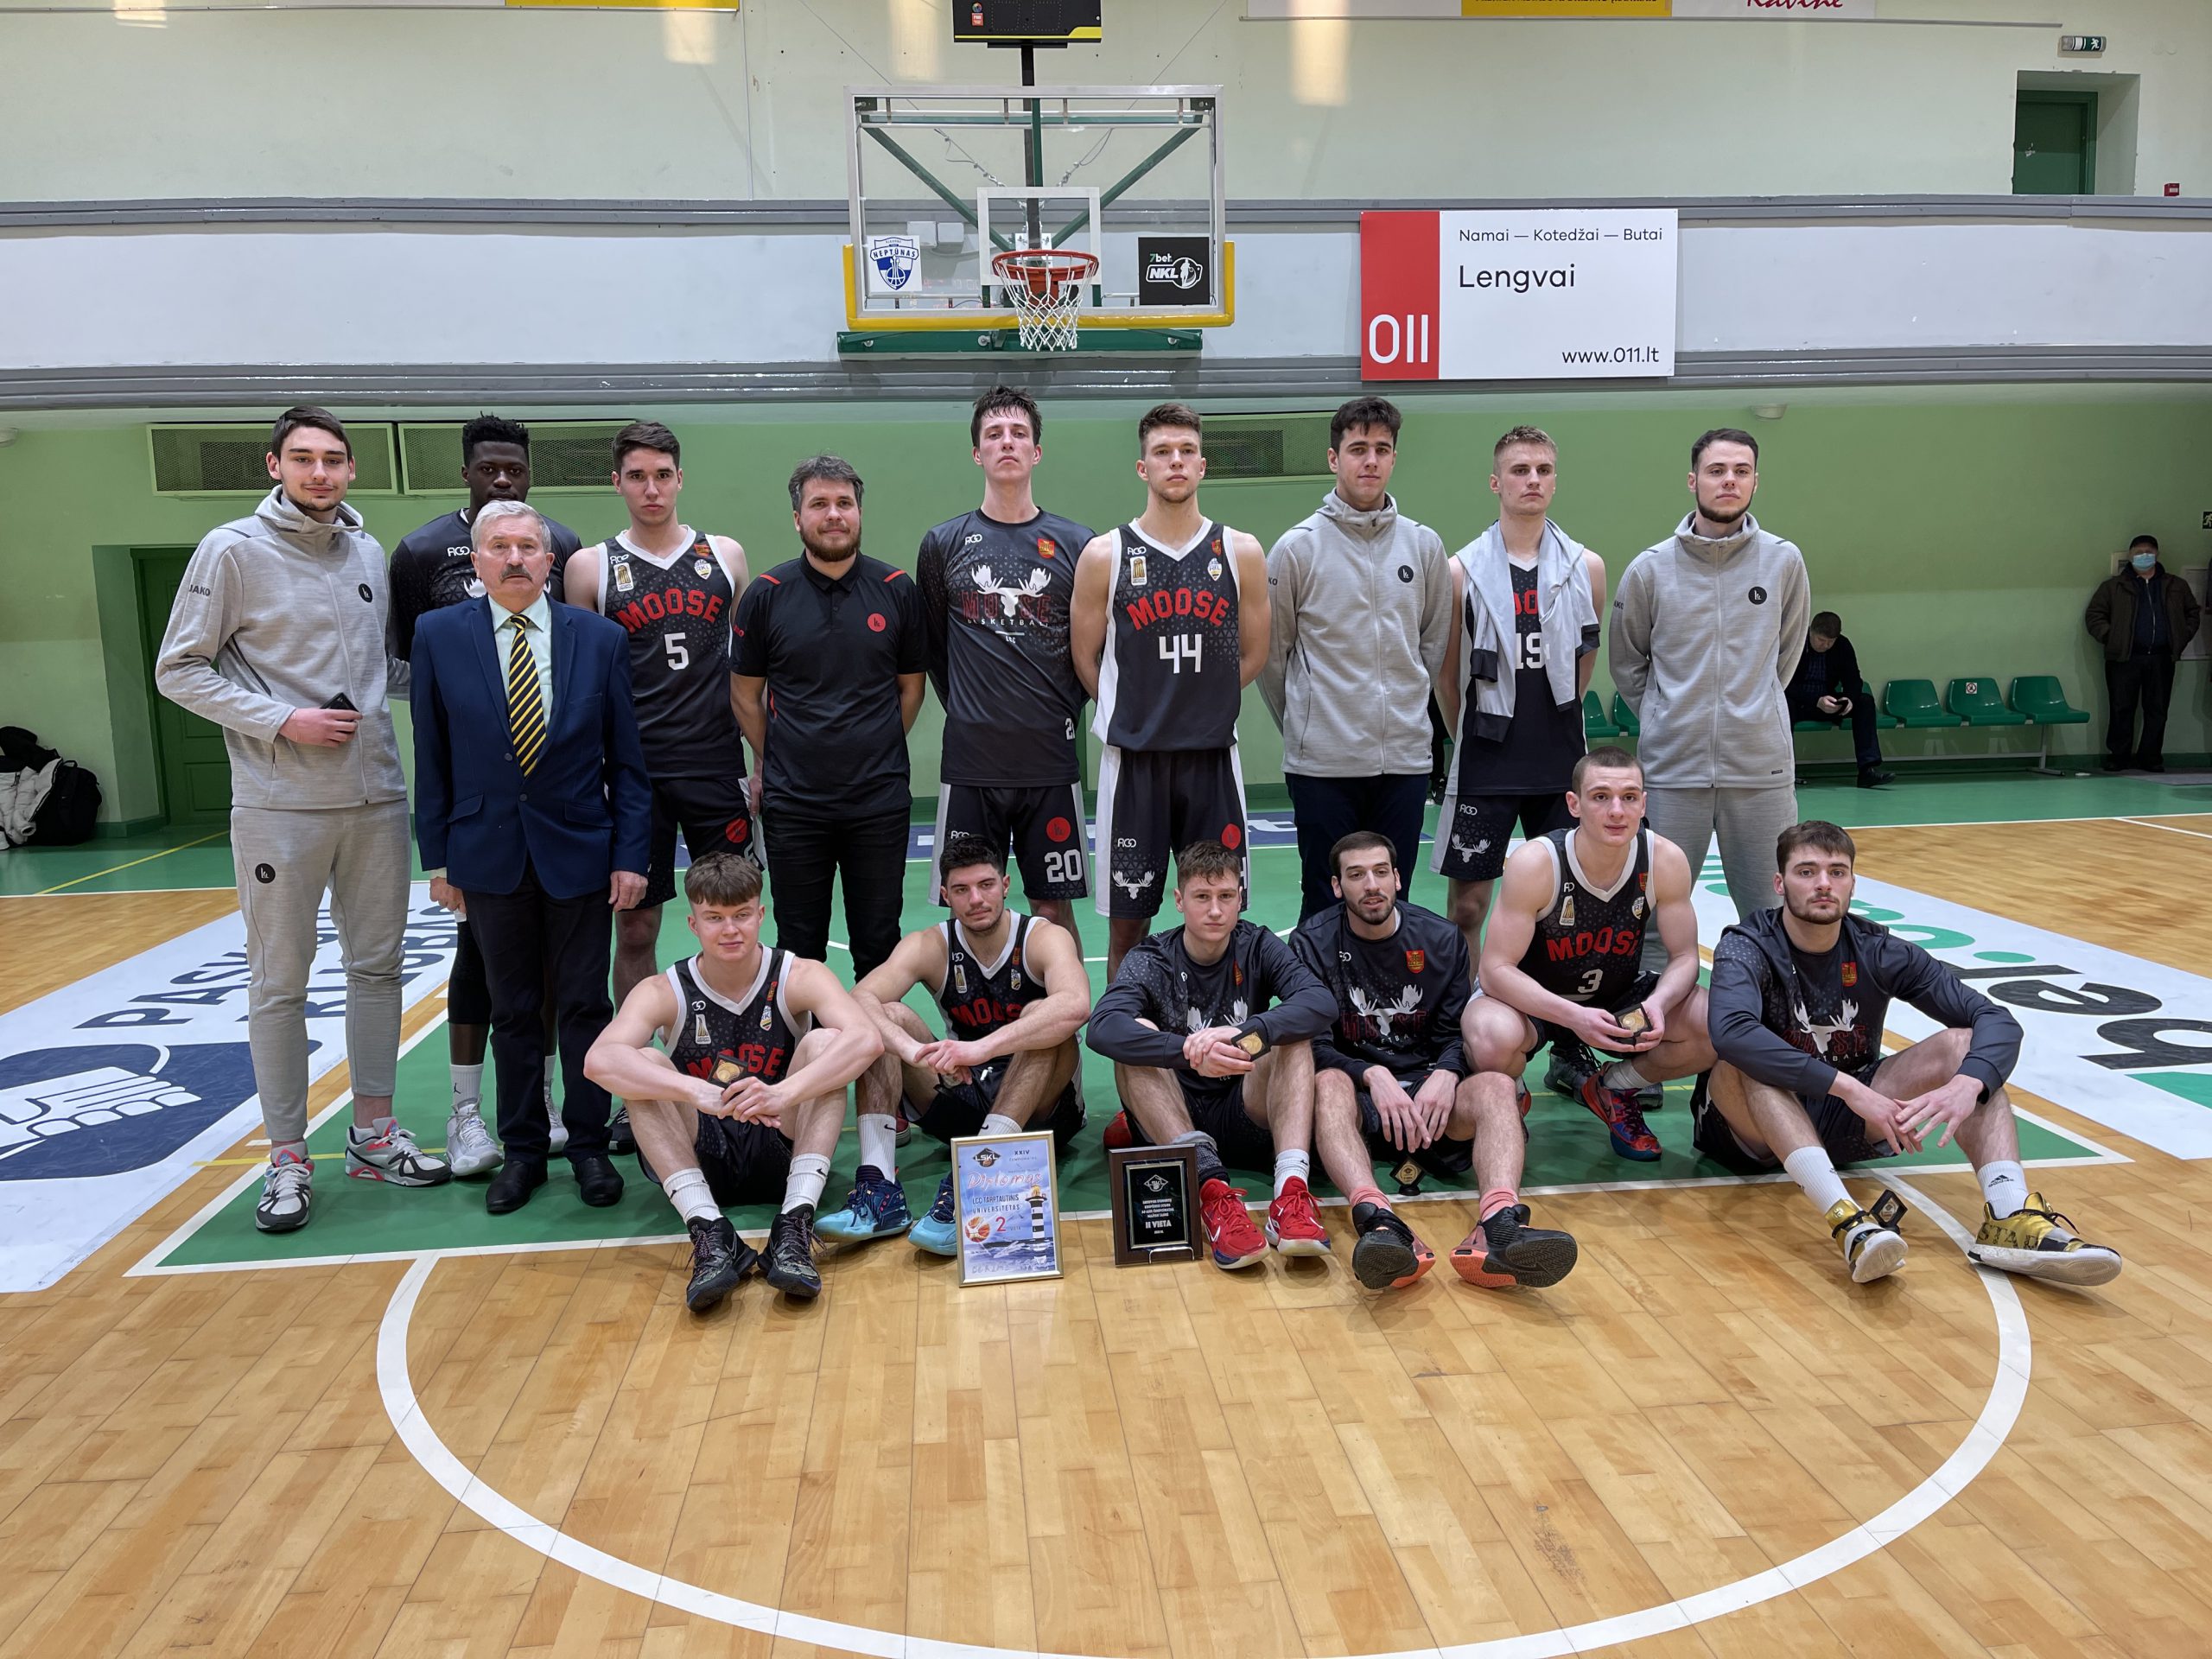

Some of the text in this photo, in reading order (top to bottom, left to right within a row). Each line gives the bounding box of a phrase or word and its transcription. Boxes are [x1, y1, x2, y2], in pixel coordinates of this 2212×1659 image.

[1459, 227, 1663, 242] Namai Kotedžai Butai
[1149, 267, 1179, 279] NKL
[1459, 263, 1576, 294] Lengvai
[1561, 346, 1660, 364] www.011.lt
[188, 584, 212, 597] JAKO
[616, 588, 724, 634] MOOSE
[1126, 587, 1230, 631] MOOSE
[664, 632, 690, 671] 5
[1159, 633, 1202, 674] 44
[1065, 717, 1076, 741] 2
[1044, 849, 1084, 883] 20
[1577, 969, 1604, 994] 3
[995, 1216, 1007, 1232] 2
